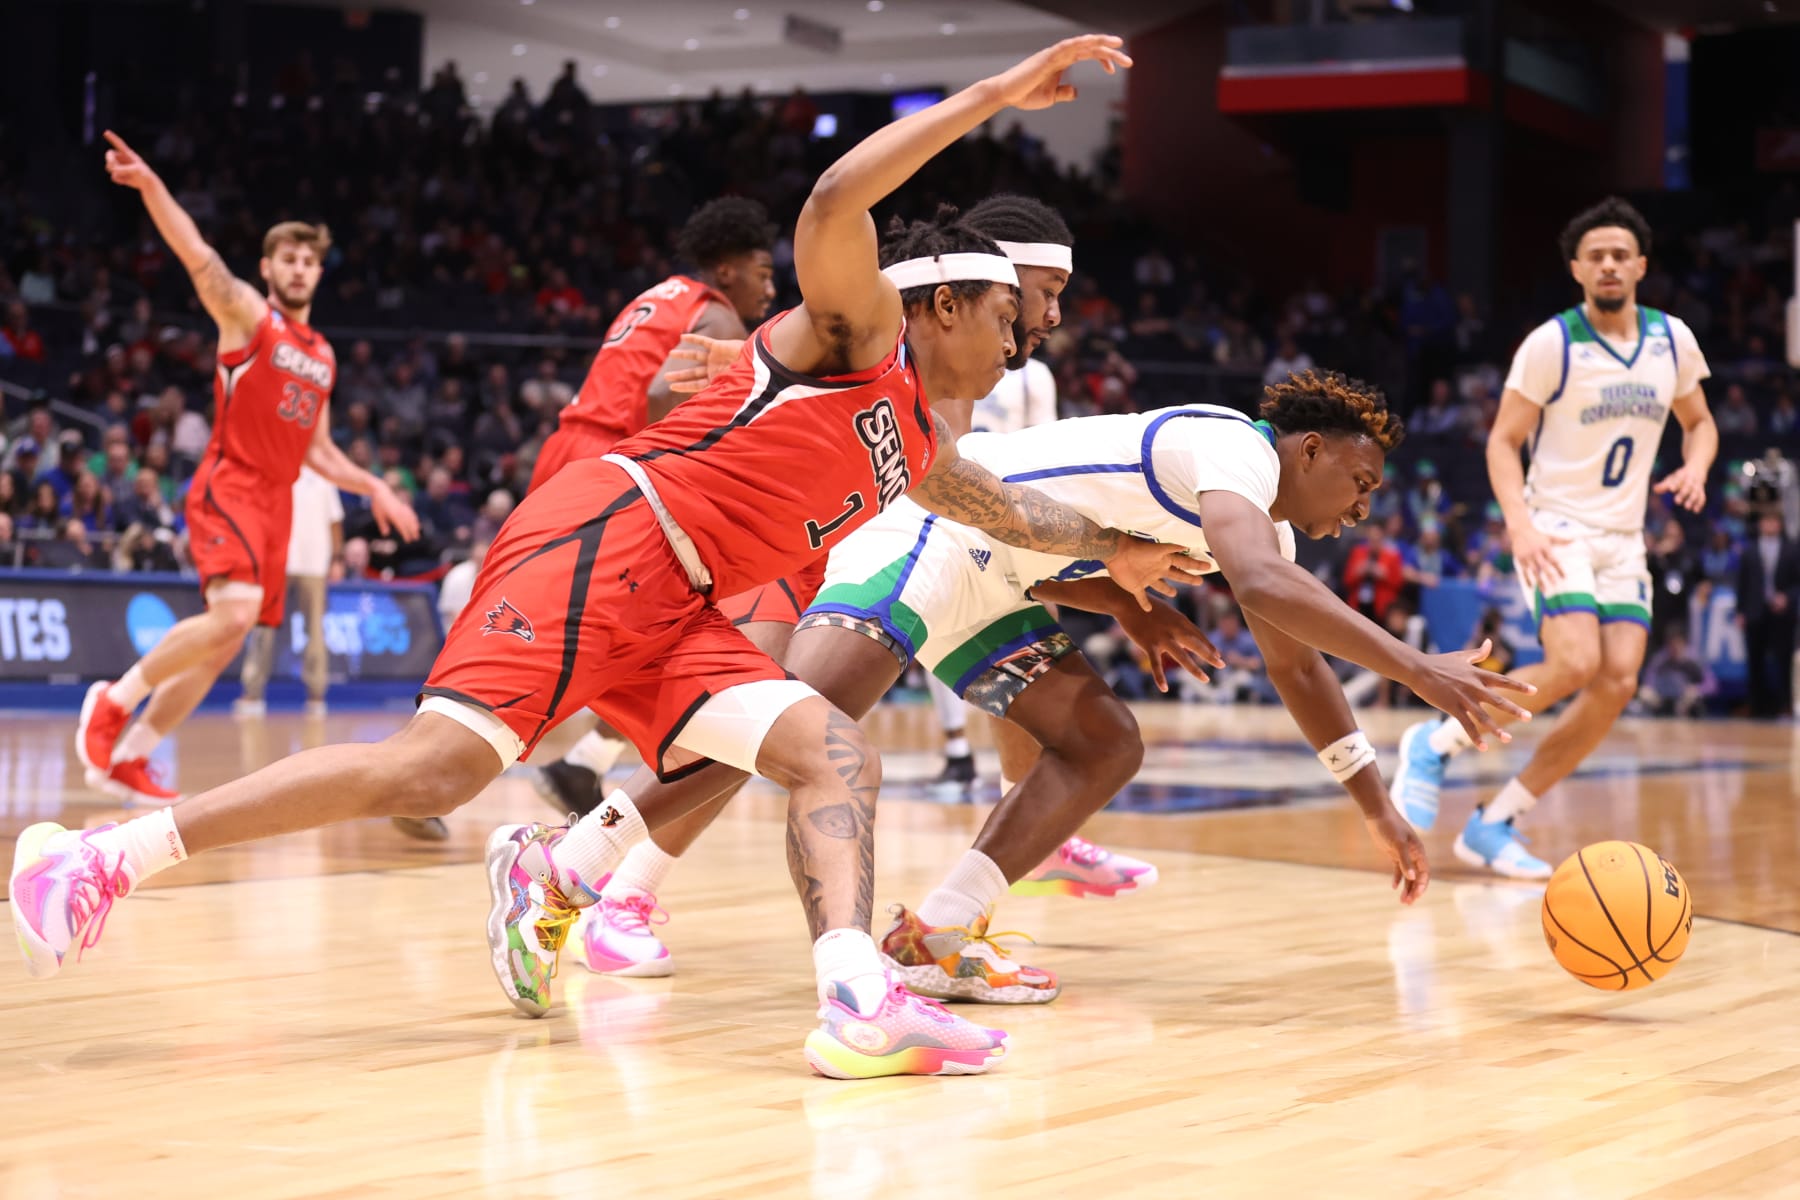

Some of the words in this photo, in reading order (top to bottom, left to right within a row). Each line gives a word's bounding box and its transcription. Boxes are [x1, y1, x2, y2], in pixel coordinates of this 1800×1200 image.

[272, 340, 334, 390] SEMO
[277, 381, 319, 428] 33
[1602, 436, 1634, 487] 0
[804, 491, 865, 550] 1
[968, 548, 986, 572] adidas
